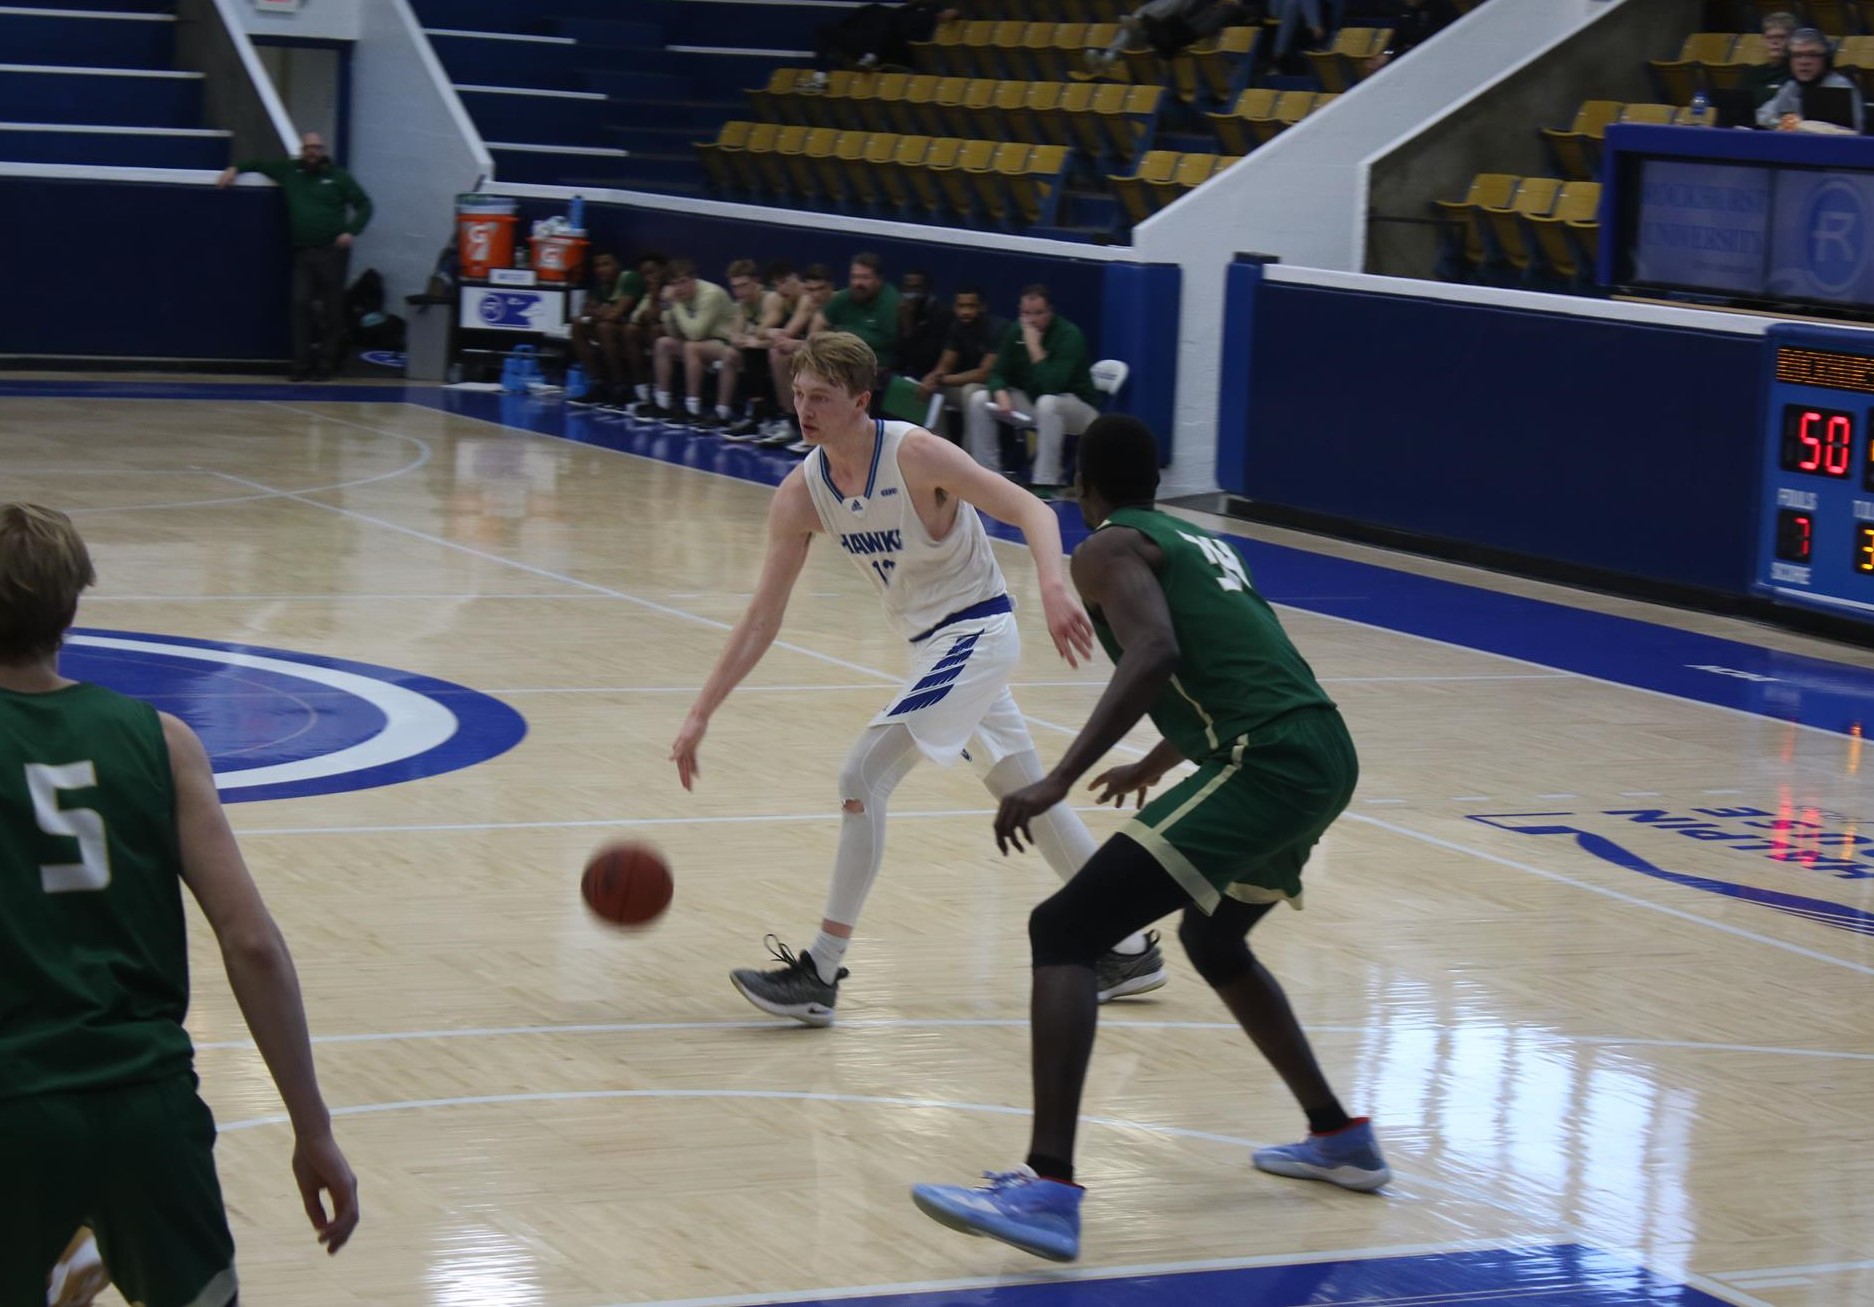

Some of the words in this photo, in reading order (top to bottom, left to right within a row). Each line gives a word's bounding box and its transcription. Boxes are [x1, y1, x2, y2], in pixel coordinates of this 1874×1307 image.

[1814, 211, 1857, 262] R
[1799, 411, 1851, 475] 50
[840, 529, 903, 555] HAWK
[1795, 517, 1811, 556] 7
[23, 759, 112, 893] 5
